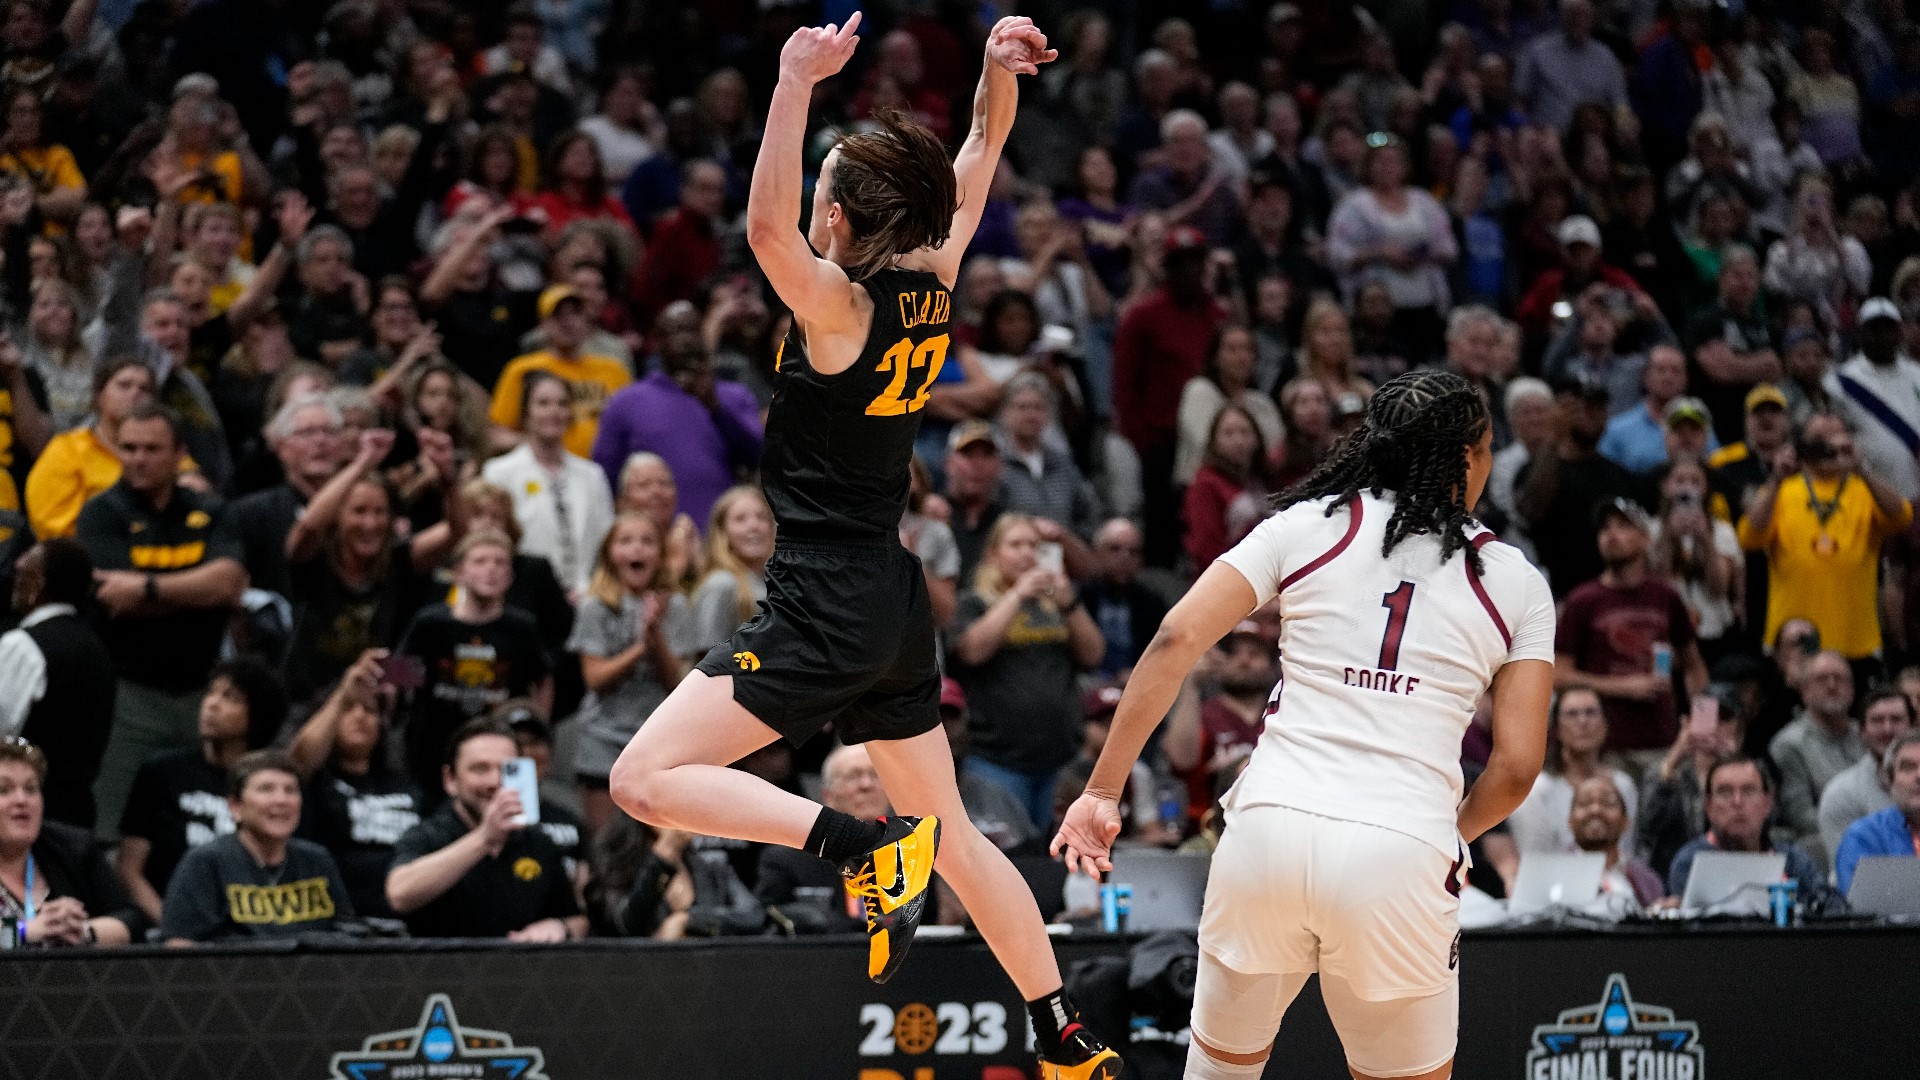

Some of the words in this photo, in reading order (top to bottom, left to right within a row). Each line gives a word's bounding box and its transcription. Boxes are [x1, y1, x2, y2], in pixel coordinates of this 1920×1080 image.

[865, 333, 950, 416] 22
[1378, 580, 1416, 671] 1
[1344, 667, 1420, 695] COOKE
[226, 877, 335, 926] IOWA
[1534, 1051, 1613, 1080] FINAL
[1619, 1050, 1695, 1080] FOUR
